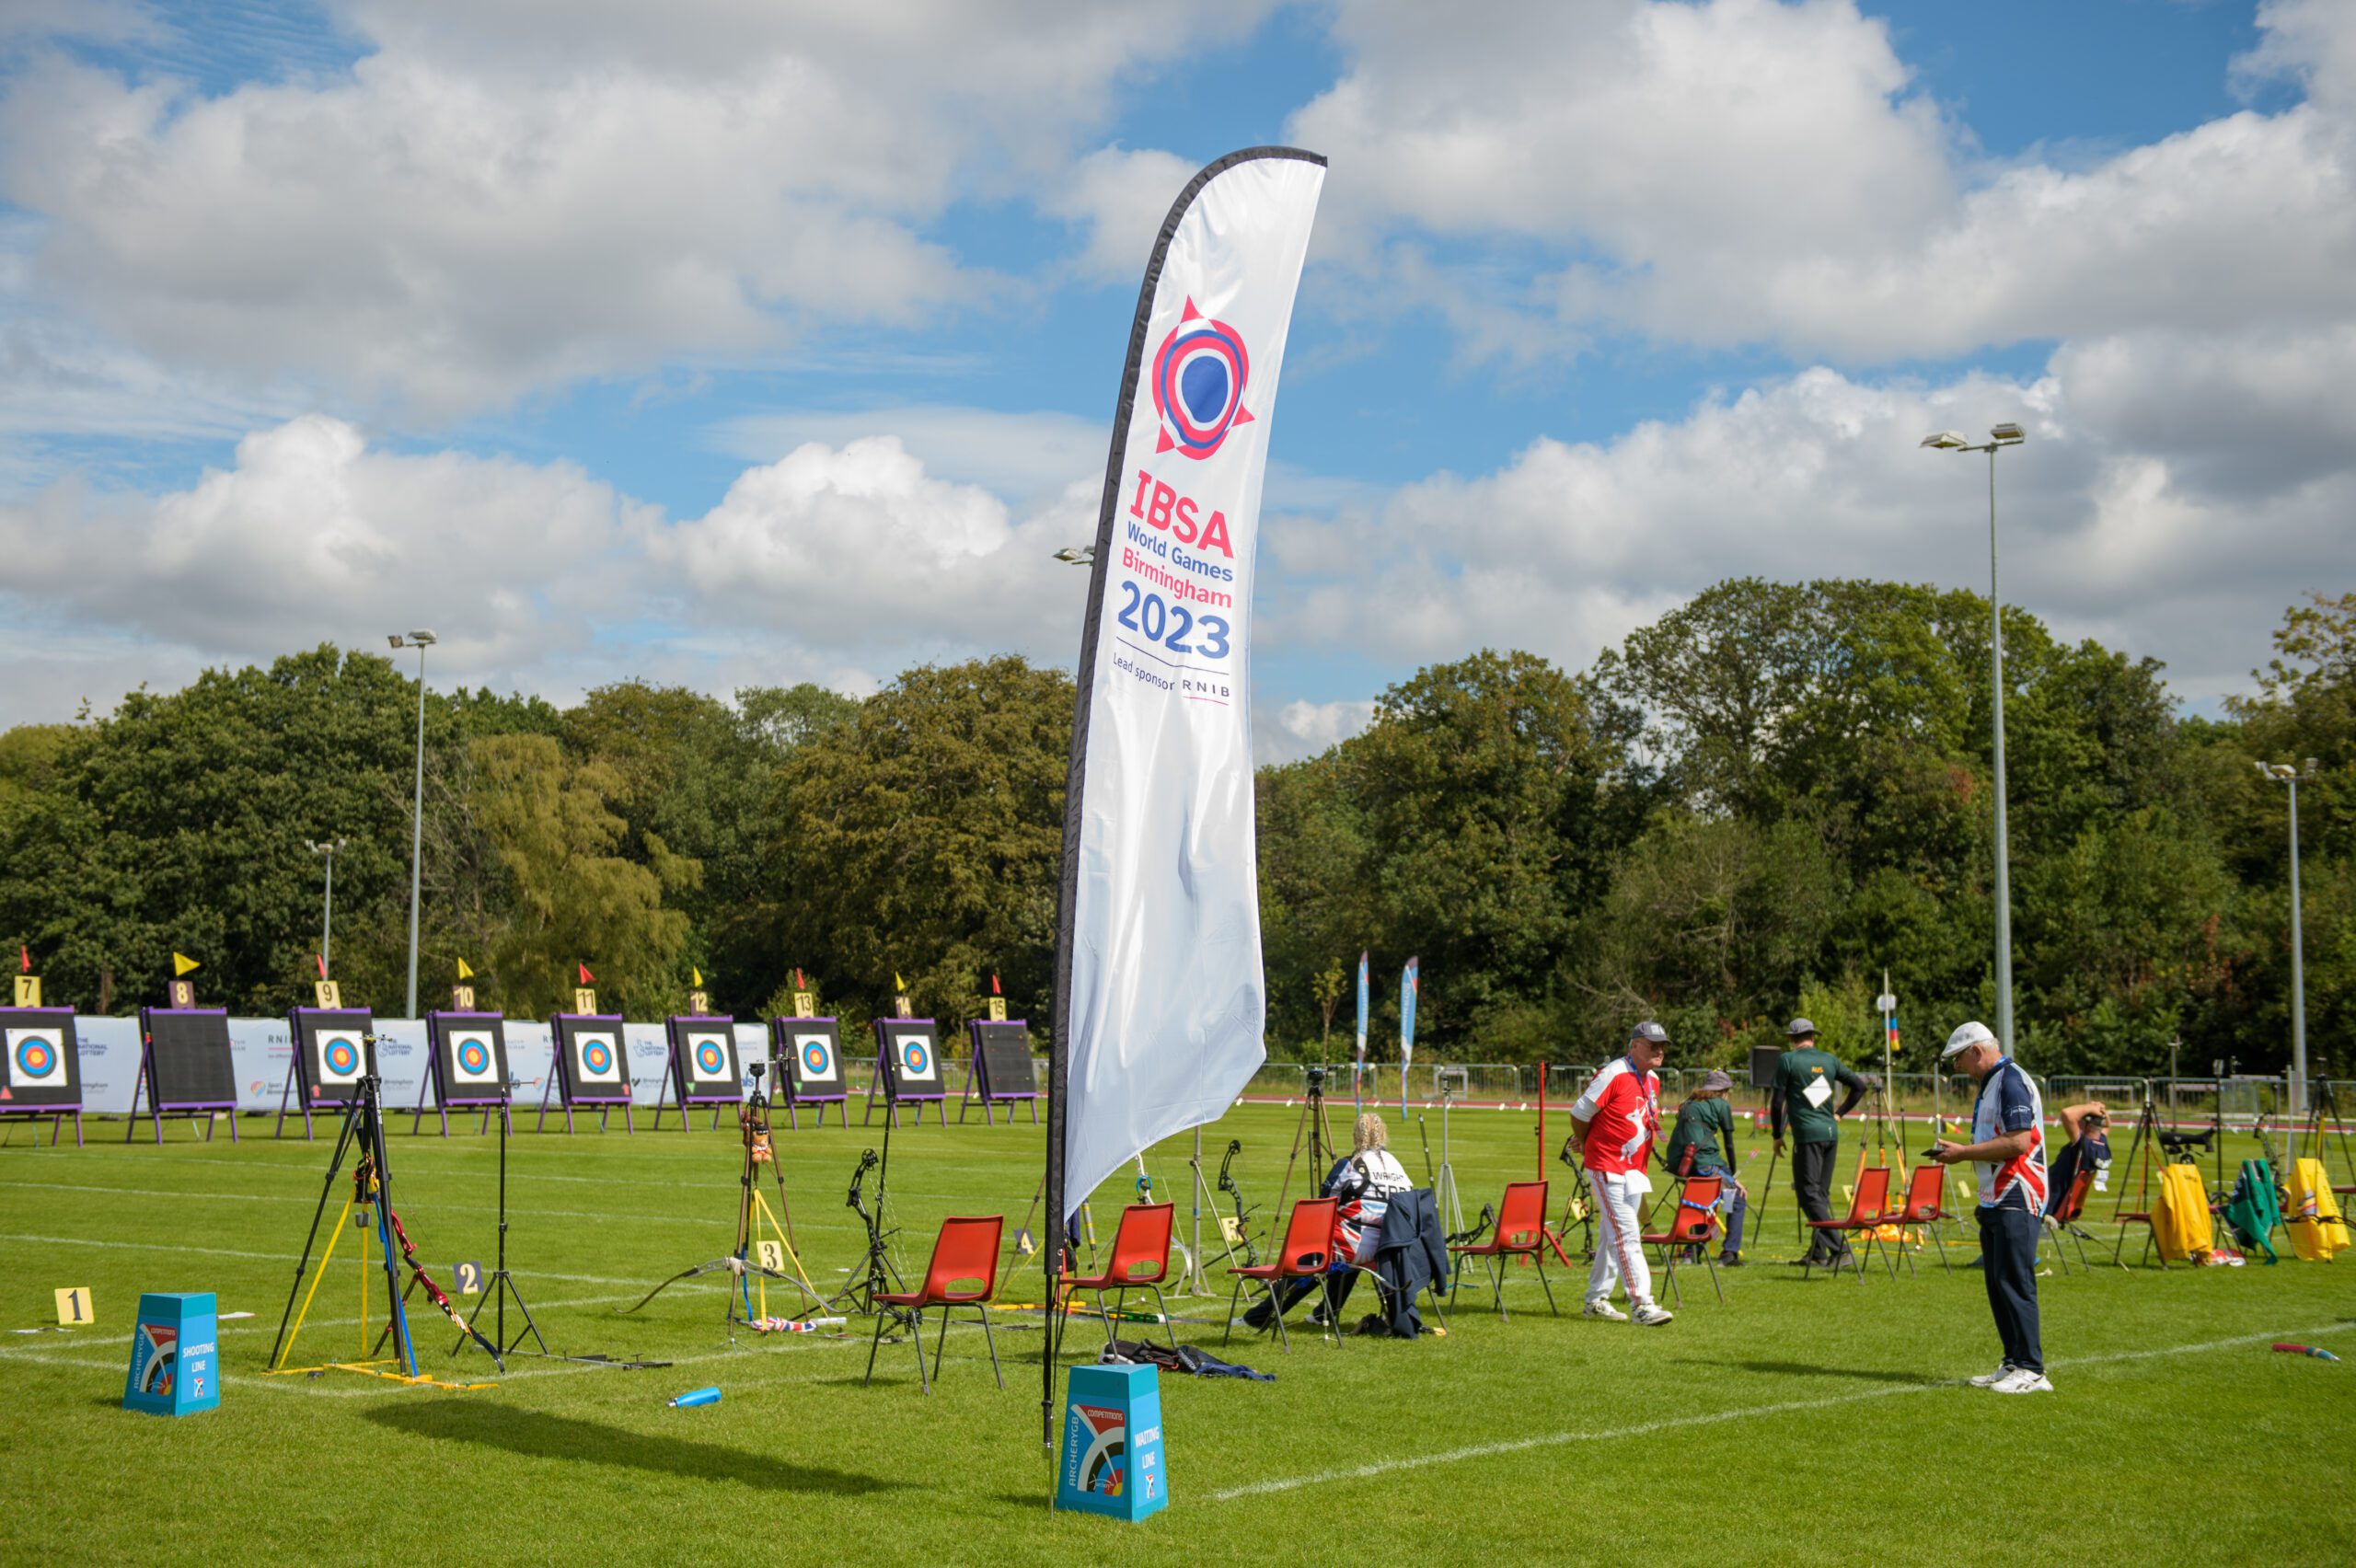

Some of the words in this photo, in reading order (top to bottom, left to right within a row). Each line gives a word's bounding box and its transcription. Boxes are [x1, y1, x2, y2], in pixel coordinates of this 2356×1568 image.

[1129, 469, 1234, 559] IBSA
[1127, 520, 1166, 557] World
[1172, 547, 1233, 582] Games
[1123, 547, 1232, 608] Birmingham
[1117, 580, 1230, 659] 2023
[1113, 651, 1133, 673] Lead
[1135, 667, 1175, 690] sponsor
[22, 978, 32, 999] 7
[176, 982, 189, 1004] 8
[322, 984, 333, 1002] 9
[454, 986, 475, 1008] 10
[577, 990, 594, 1010] 11
[690, 991, 708, 1011] 12
[797, 995, 813, 1012] 13
[895, 997, 911, 1015] 14
[992, 997, 1005, 1015] 15
[1021, 1232, 1036, 1254] 4
[764, 1243, 779, 1271] 3
[460, 1262, 479, 1294] 2
[68, 1289, 83, 1320] 1
[182, 1342, 214, 1358] SHOOTING
[191, 1360, 206, 1372] LINE
[1087, 1409, 1124, 1421] COMPETITIONS
[1134, 1425, 1160, 1448] WAITING
[1068, 1415, 1080, 1487] ARCHERYGB
[1142, 1451, 1155, 1470] LINE
